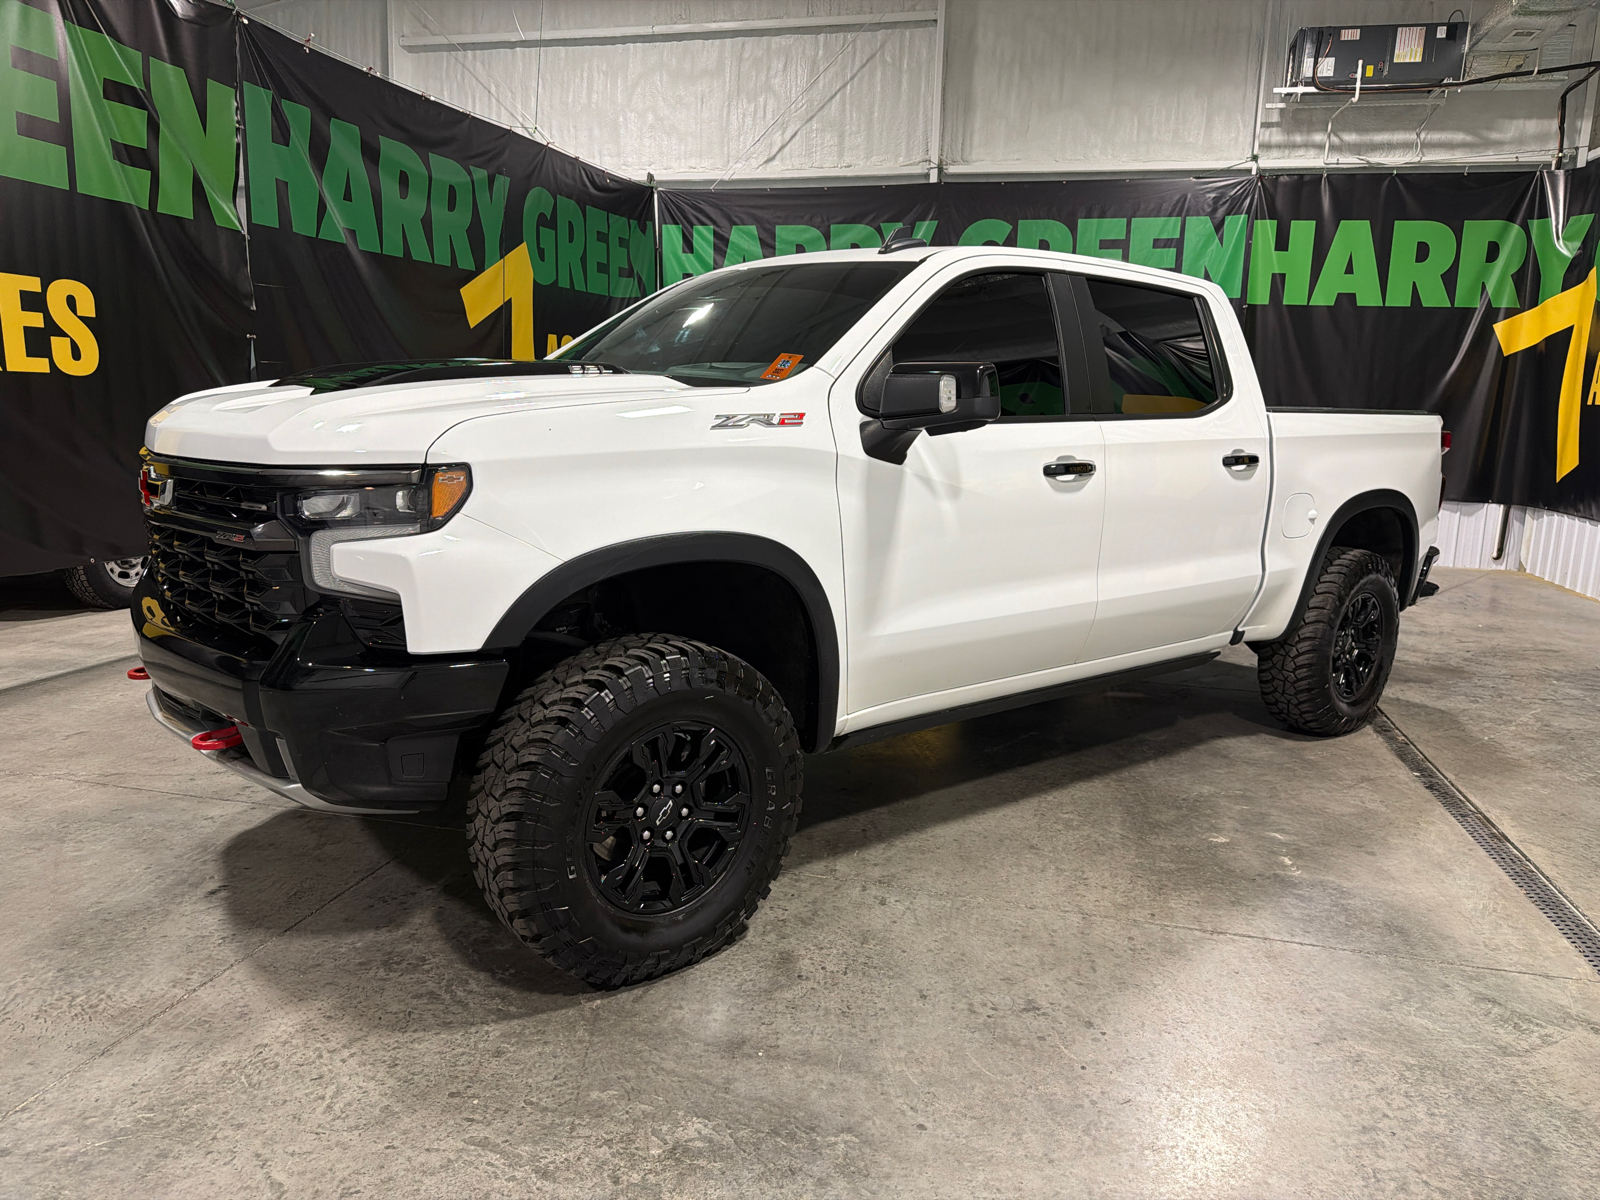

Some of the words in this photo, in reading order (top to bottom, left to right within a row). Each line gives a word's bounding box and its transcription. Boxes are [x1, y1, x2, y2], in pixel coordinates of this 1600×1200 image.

[243, 81, 510, 271] HARRY
[522, 186, 656, 298] GREEN
[1247, 213, 1595, 308] HARRY
[710, 412, 806, 430] ZR2
[216, 530, 246, 543] ZR2
